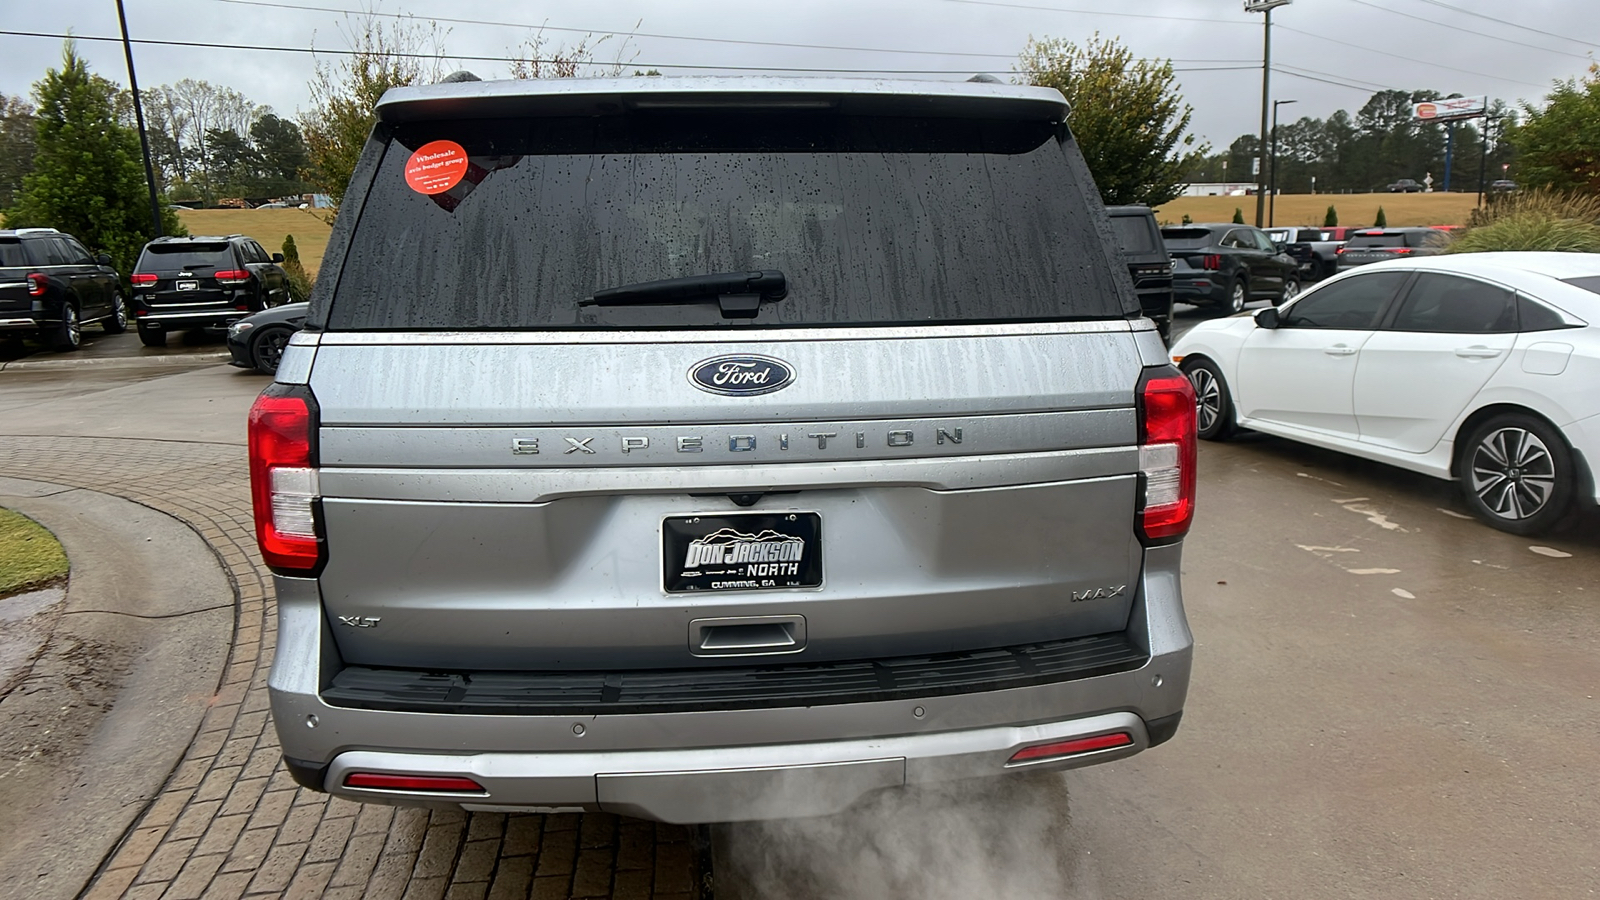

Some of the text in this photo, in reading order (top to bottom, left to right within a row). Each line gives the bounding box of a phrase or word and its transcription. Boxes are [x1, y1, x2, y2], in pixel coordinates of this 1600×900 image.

[416, 150, 455, 163] Wholesale
[422, 162, 444, 170] budget
[445, 158, 463, 166] group
[713, 361, 771, 385] Ford
[512, 427, 963, 455] EXPEDITION
[747, 563, 799, 577] NORTH
[711, 580, 759, 589] CUMMING,
[761, 579, 776, 587] GA
[1071, 584, 1127, 602] MAX
[338, 615, 382, 629] XLT
